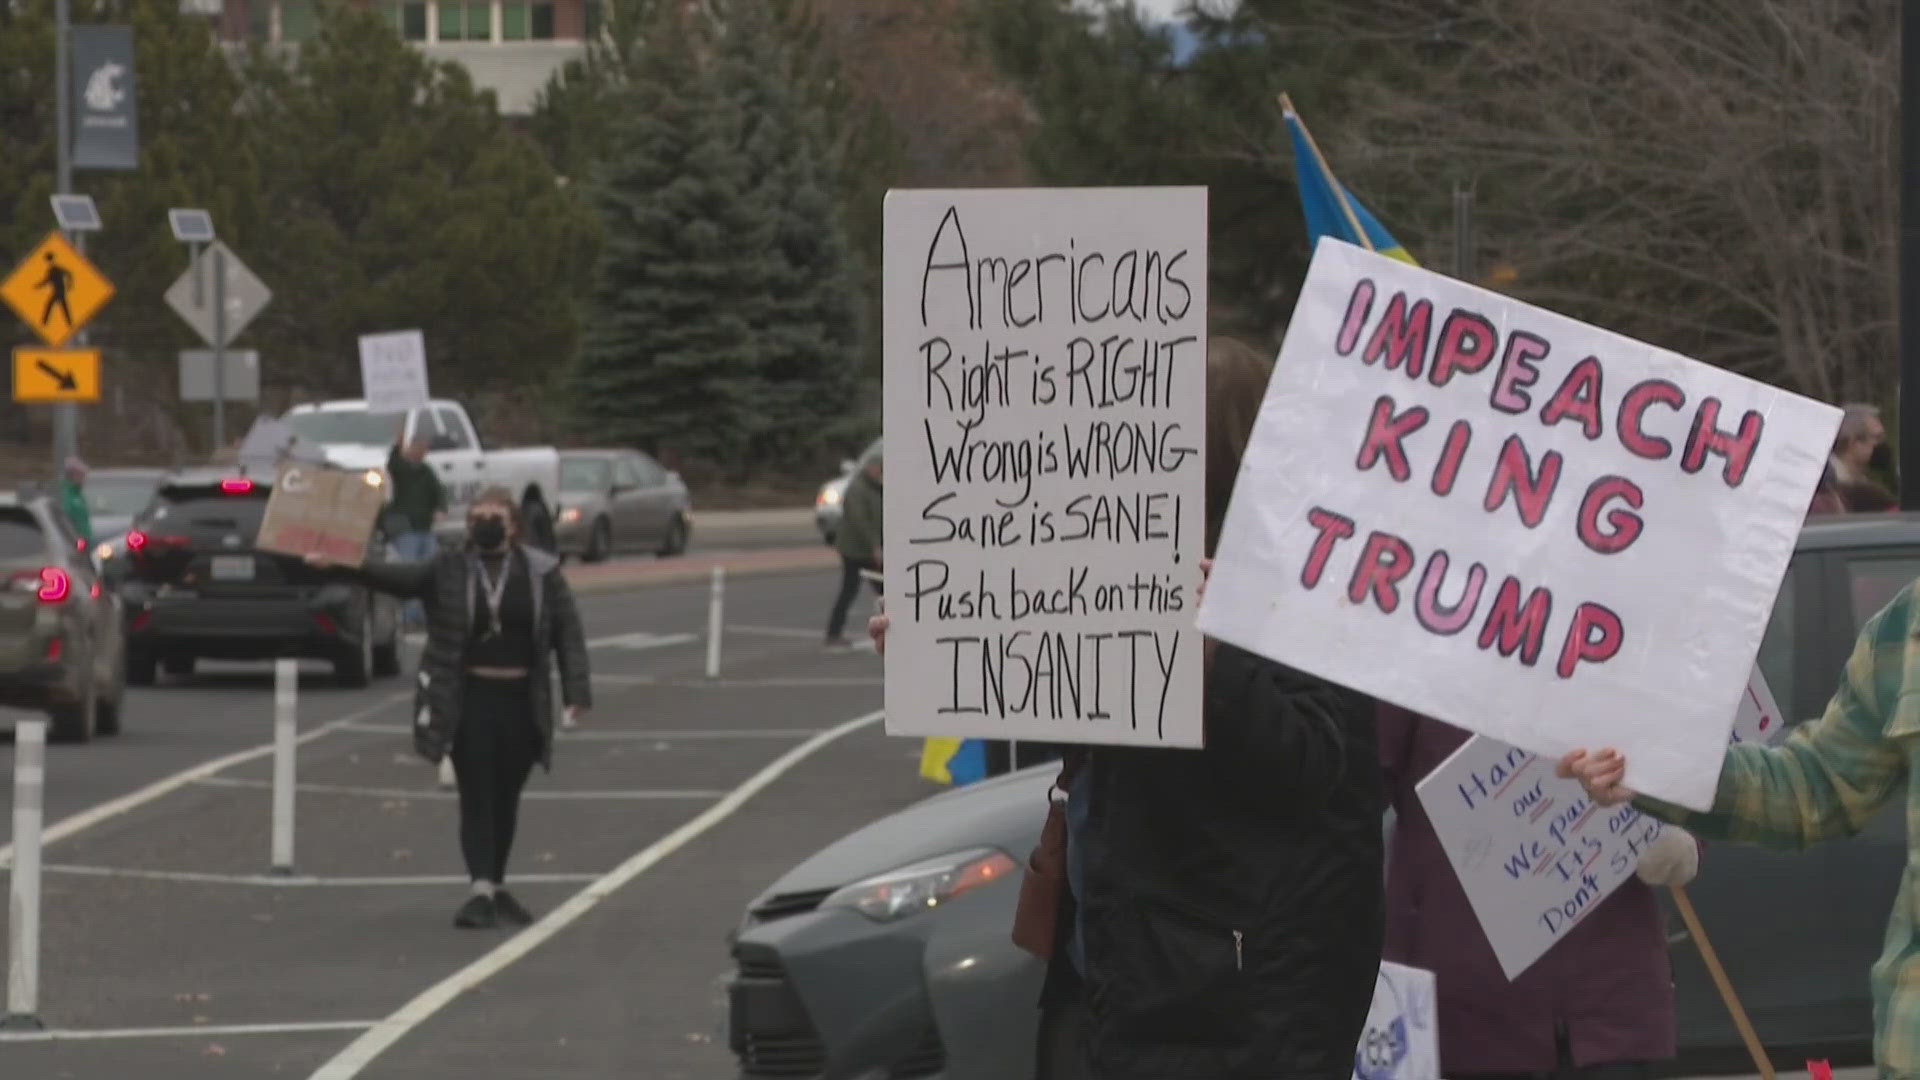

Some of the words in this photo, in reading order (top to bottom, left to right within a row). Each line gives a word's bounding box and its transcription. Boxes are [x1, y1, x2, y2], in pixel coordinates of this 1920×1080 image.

[921, 205, 1191, 330] Americans
[919, 336, 1029, 430] Right
[1032, 354, 1057, 406] is
[1066, 335, 1198, 408] RIGHT
[1334, 277, 1766, 489] IMPEACH
[925, 418, 1032, 507] Wrong
[1037, 431, 1059, 476] is
[1063, 420, 1199, 481] WRONG
[1354, 394, 1646, 556] KING
[909, 492, 1022, 549] Sane
[1031, 501, 1056, 546] is
[1060, 492, 1181, 565] SANE!
[905, 560, 1002, 622] Push
[1011, 566, 1089, 621] back
[1095, 582, 1124, 613] on
[1127, 573, 1184, 616] this
[1299, 507, 1626, 681] TRUMP
[936, 630, 1180, 740] INSANITY
[1458, 746, 1527, 810] Han
[1503, 841, 1546, 879] We
